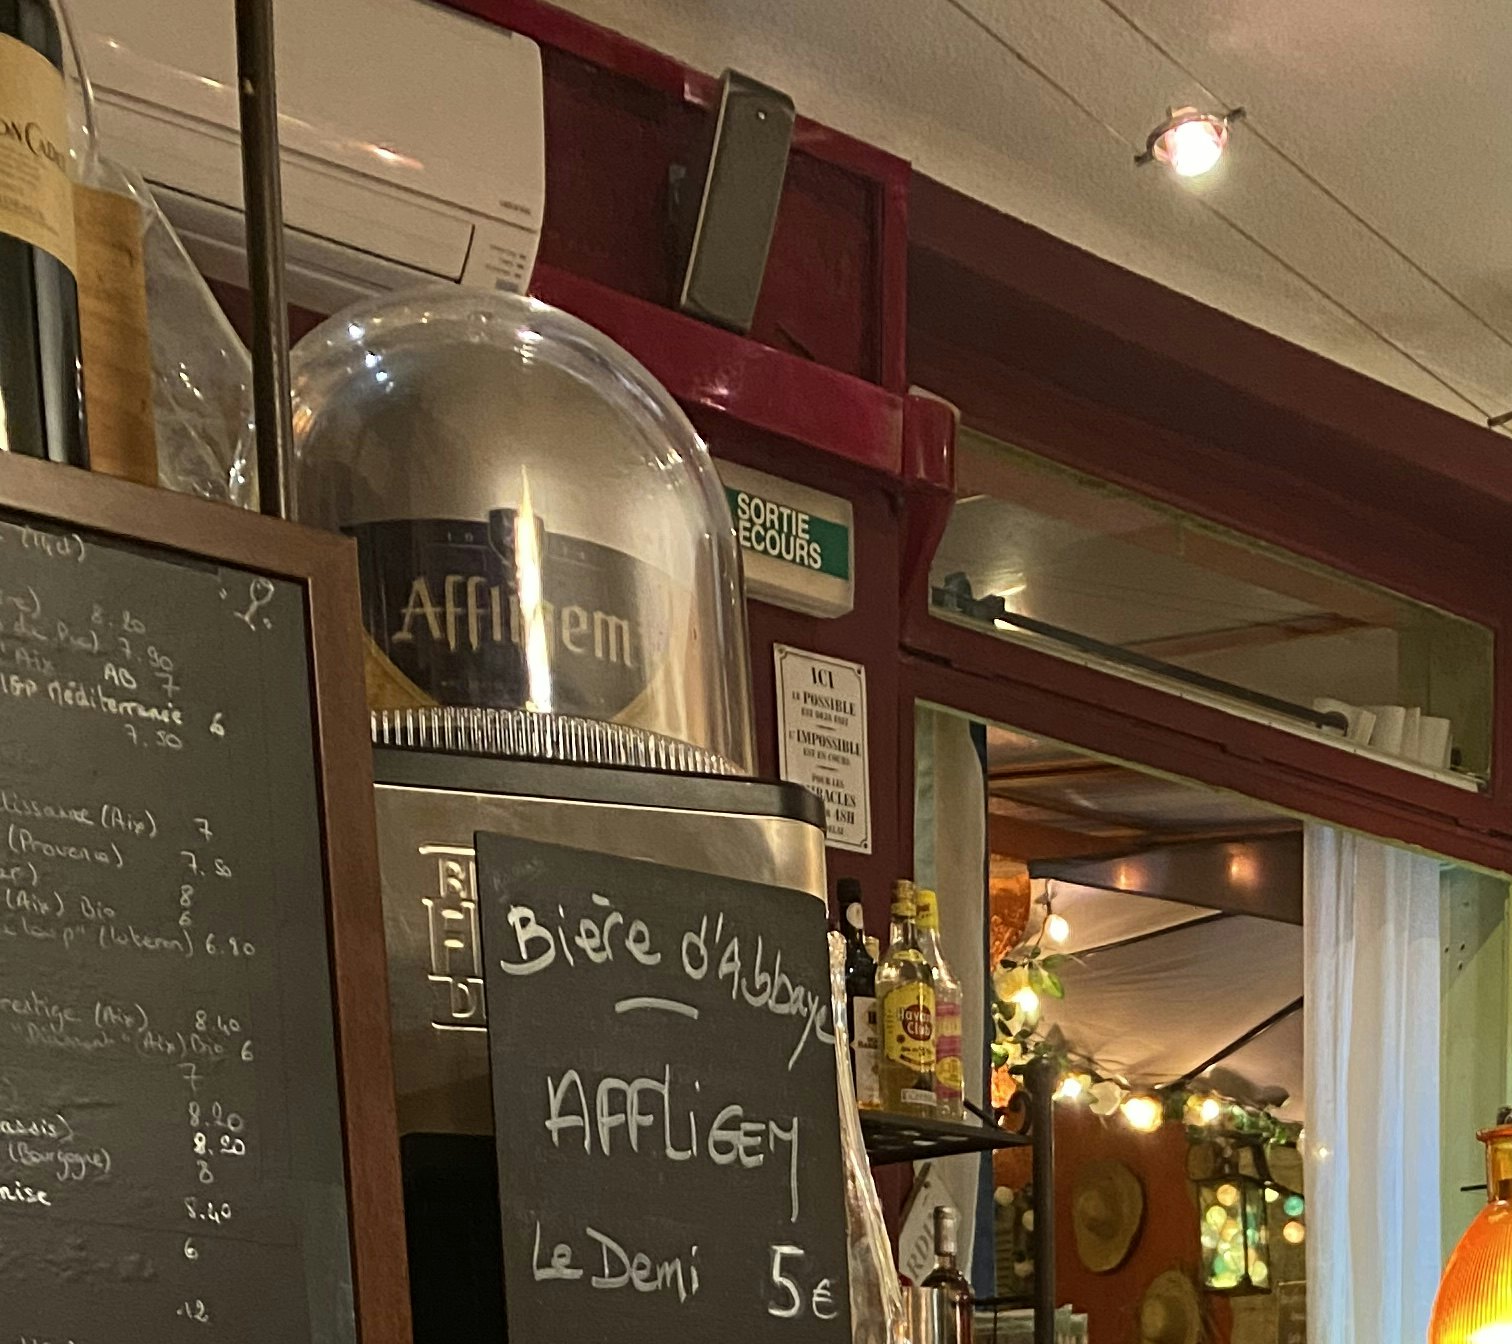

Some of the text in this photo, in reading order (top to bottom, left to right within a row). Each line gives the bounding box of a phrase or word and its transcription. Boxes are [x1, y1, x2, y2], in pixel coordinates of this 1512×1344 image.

[738, 492, 810, 540] SORTIE
[739, 520, 822, 570] ECOURS
[392, 575, 634, 668] Affliem
[811, 666, 834, 689] ICI
[803, 691, 855, 716] POSSIBLE
[209, 712, 225, 736] 6
[194, 817, 213, 841] 7
[180, 884, 194, 907] 8
[500, 893, 836, 1072] Bière d'Abbaye
[241, 1040, 254, 1061] 6
[177, 1063, 203, 1091] 7
[197, 1159, 214, 1184] 8
[184, 1237, 199, 1259] 6
[534, 1221, 583, 1281] Le
[586, 1226, 700, 1303] Demi
